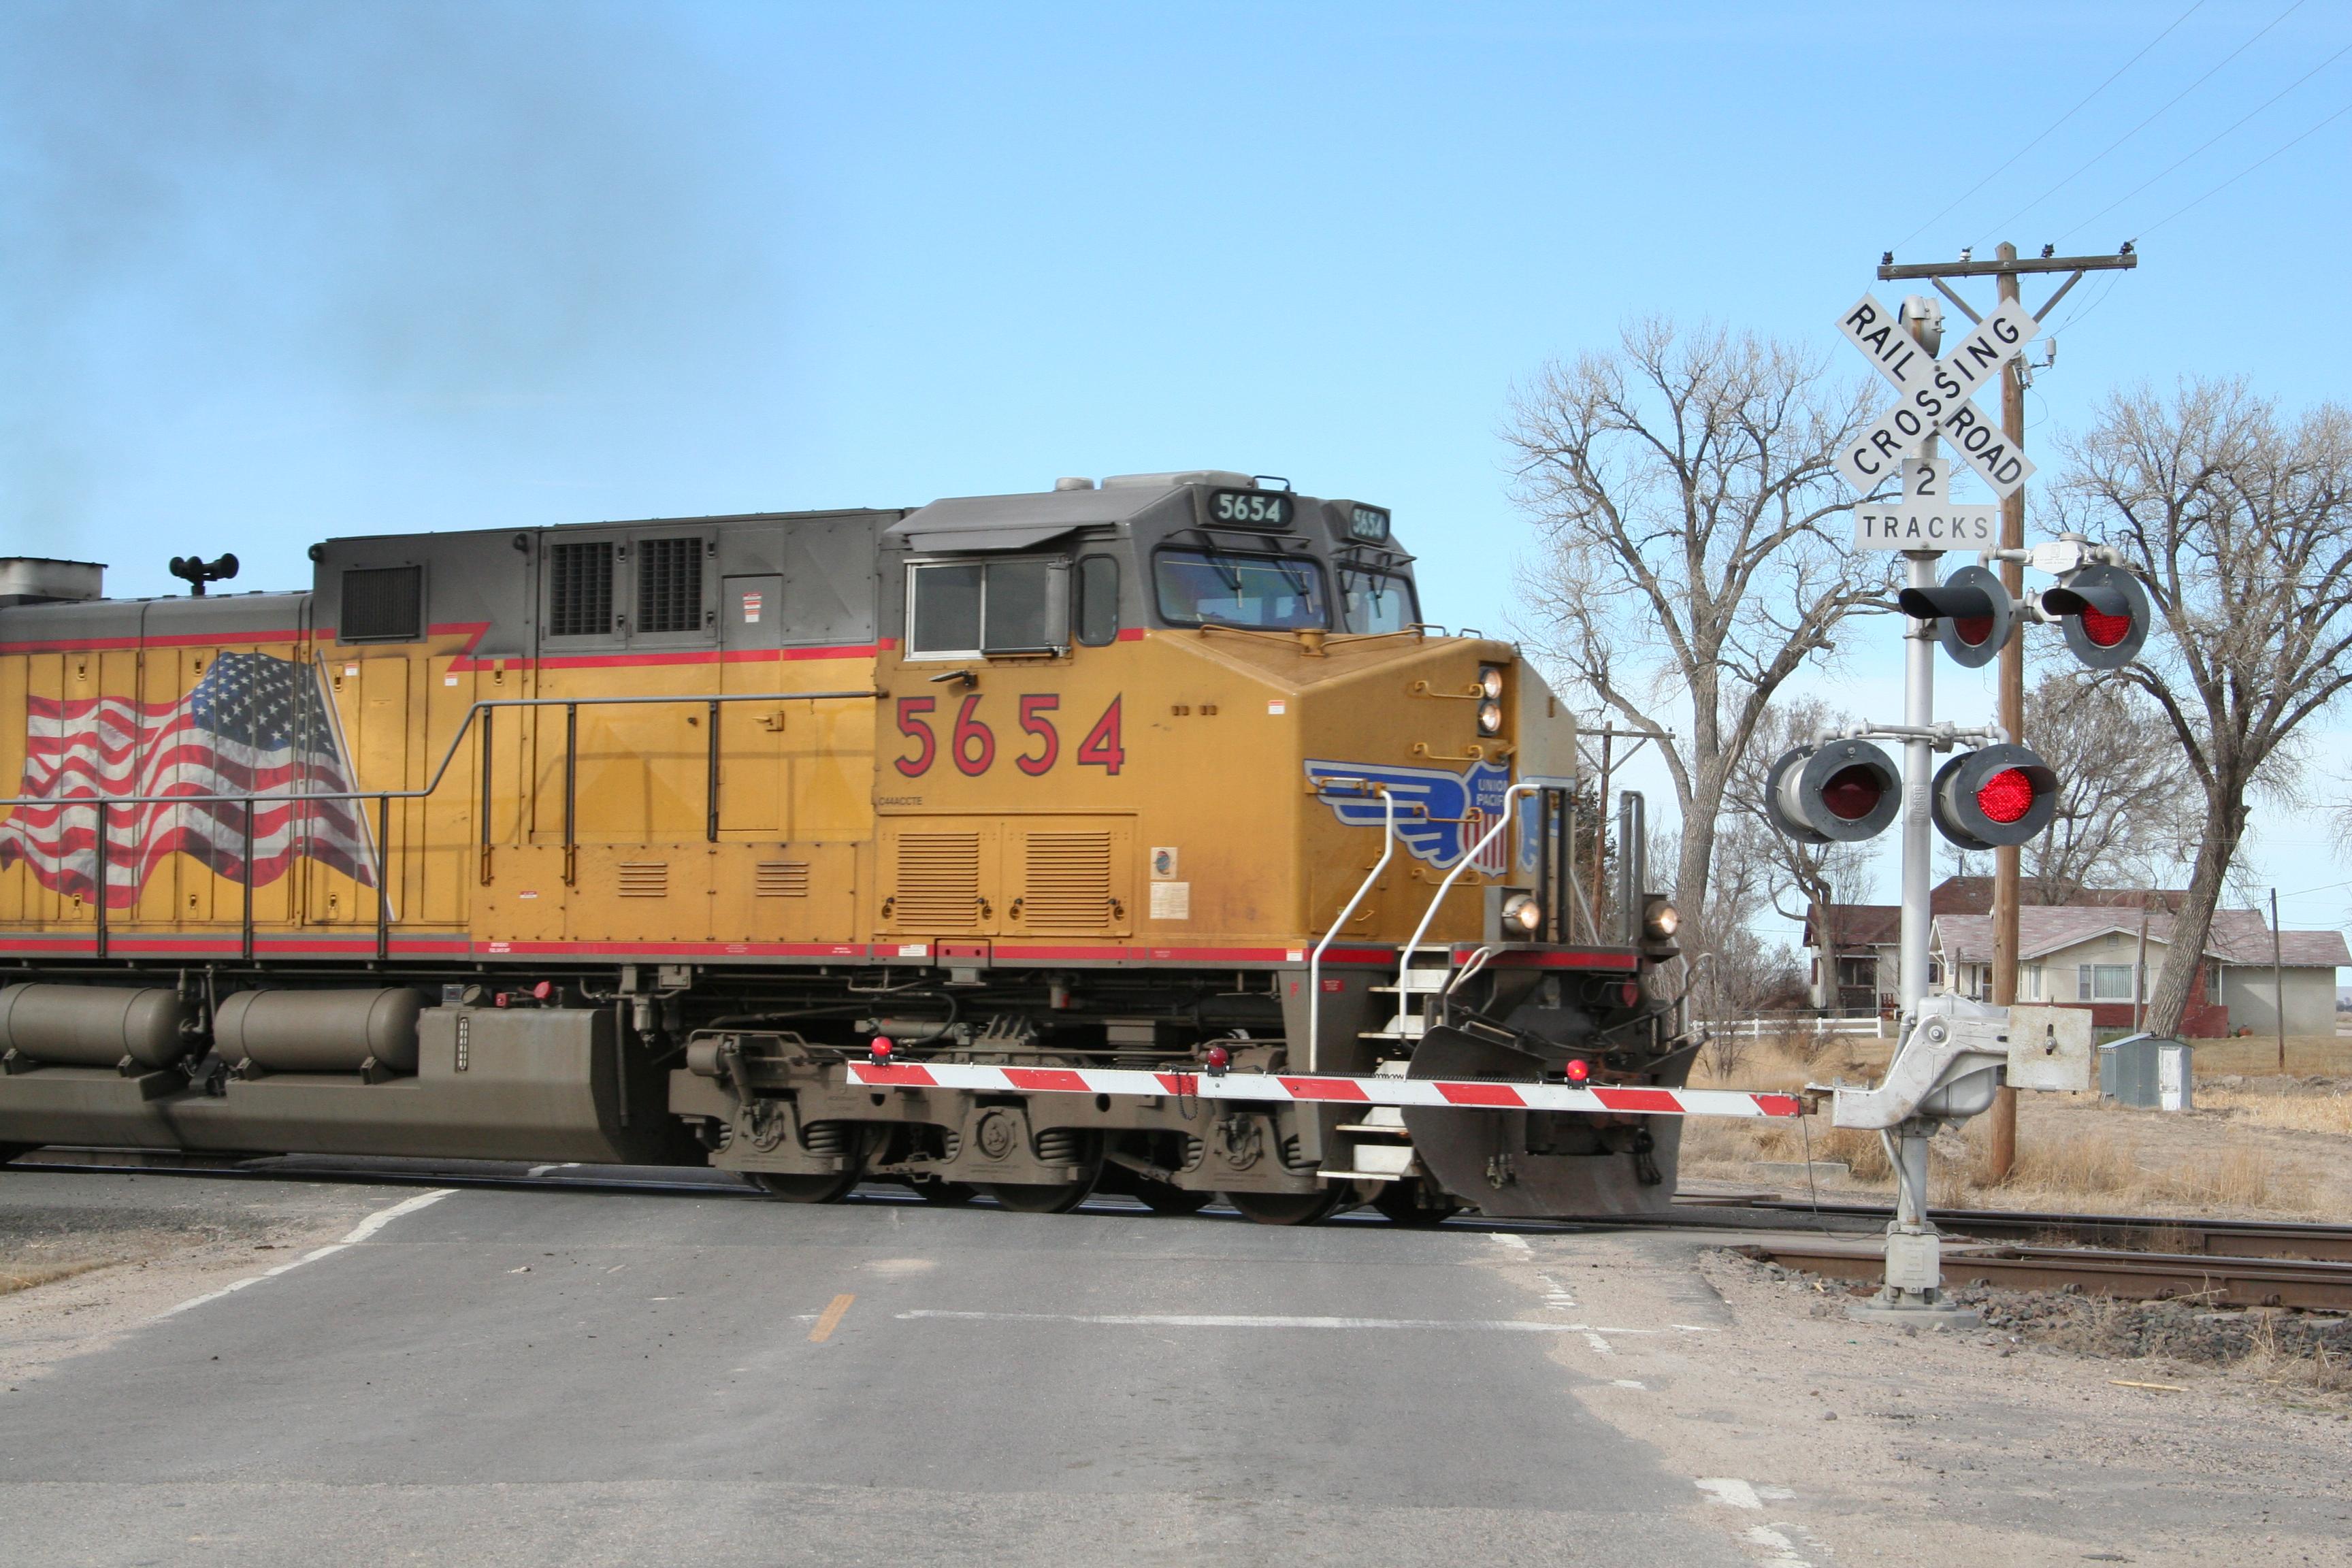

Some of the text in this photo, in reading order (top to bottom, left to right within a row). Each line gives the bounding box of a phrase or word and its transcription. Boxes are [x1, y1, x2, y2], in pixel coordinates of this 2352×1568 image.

[1846, 304, 2022, 485] RAIL ROAD
[1853, 317, 2019, 475] CROSSING
[1916, 467, 1936, 495] 2
[1218, 493, 1281, 523] 5654
[1352, 508, 1385, 540] 5654
[1863, 517, 1988, 540] TRACKS
[894, 691, 1125, 779] 5654
[1476, 794, 1504, 806] PACIF
